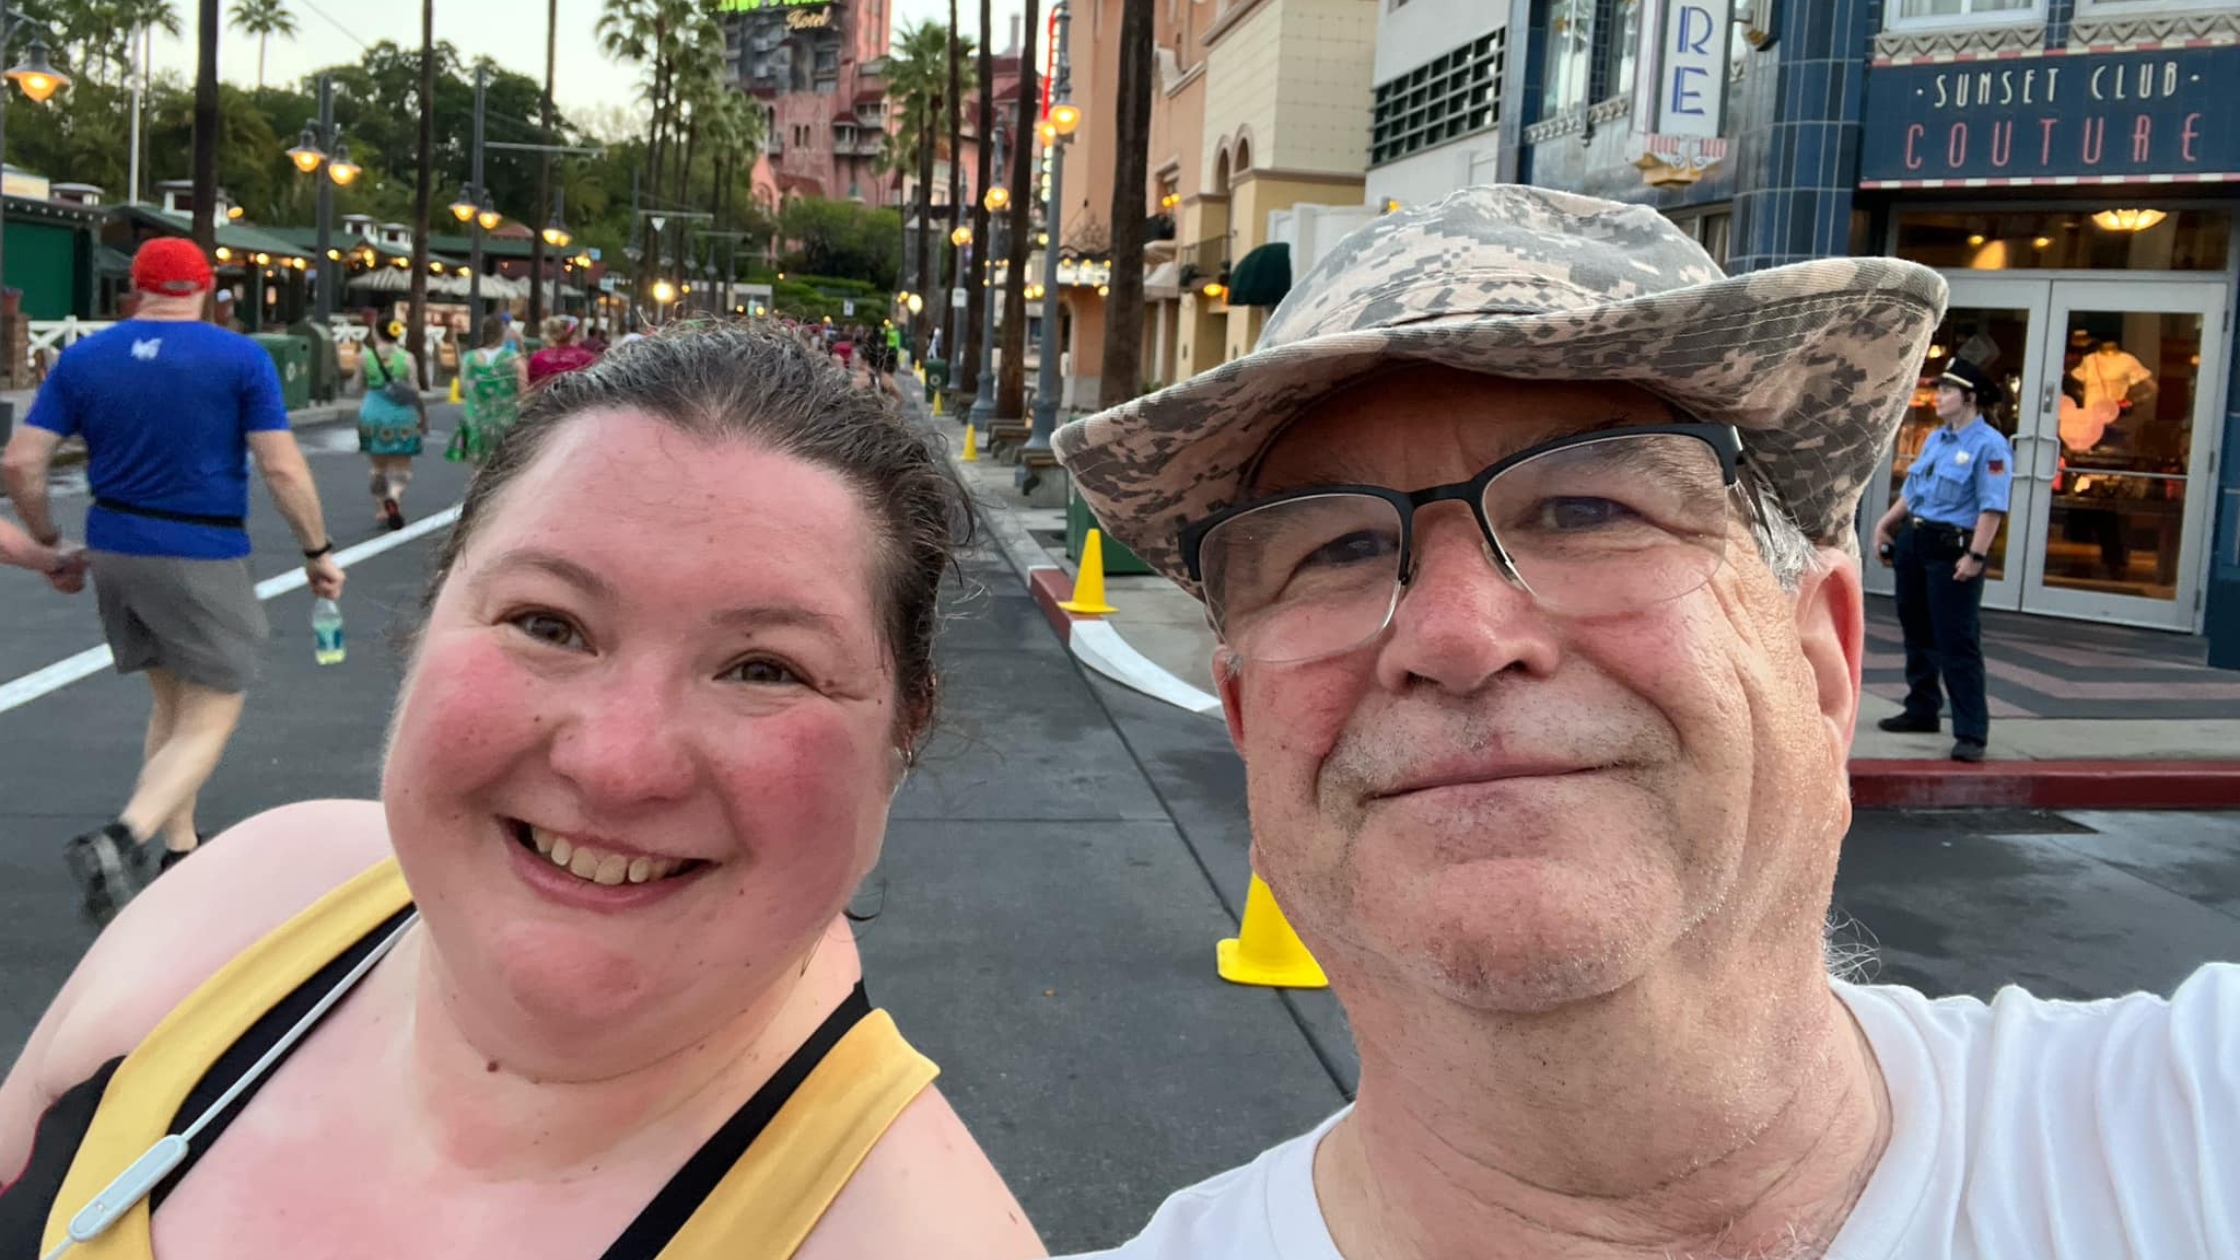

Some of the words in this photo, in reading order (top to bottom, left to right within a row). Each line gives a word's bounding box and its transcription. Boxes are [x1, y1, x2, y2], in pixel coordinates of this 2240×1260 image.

[1934, 67, 2059, 108] SUNSET
[2091, 61, 2179, 100] CLUB
[1905, 112, 2201, 170] COUTURE
